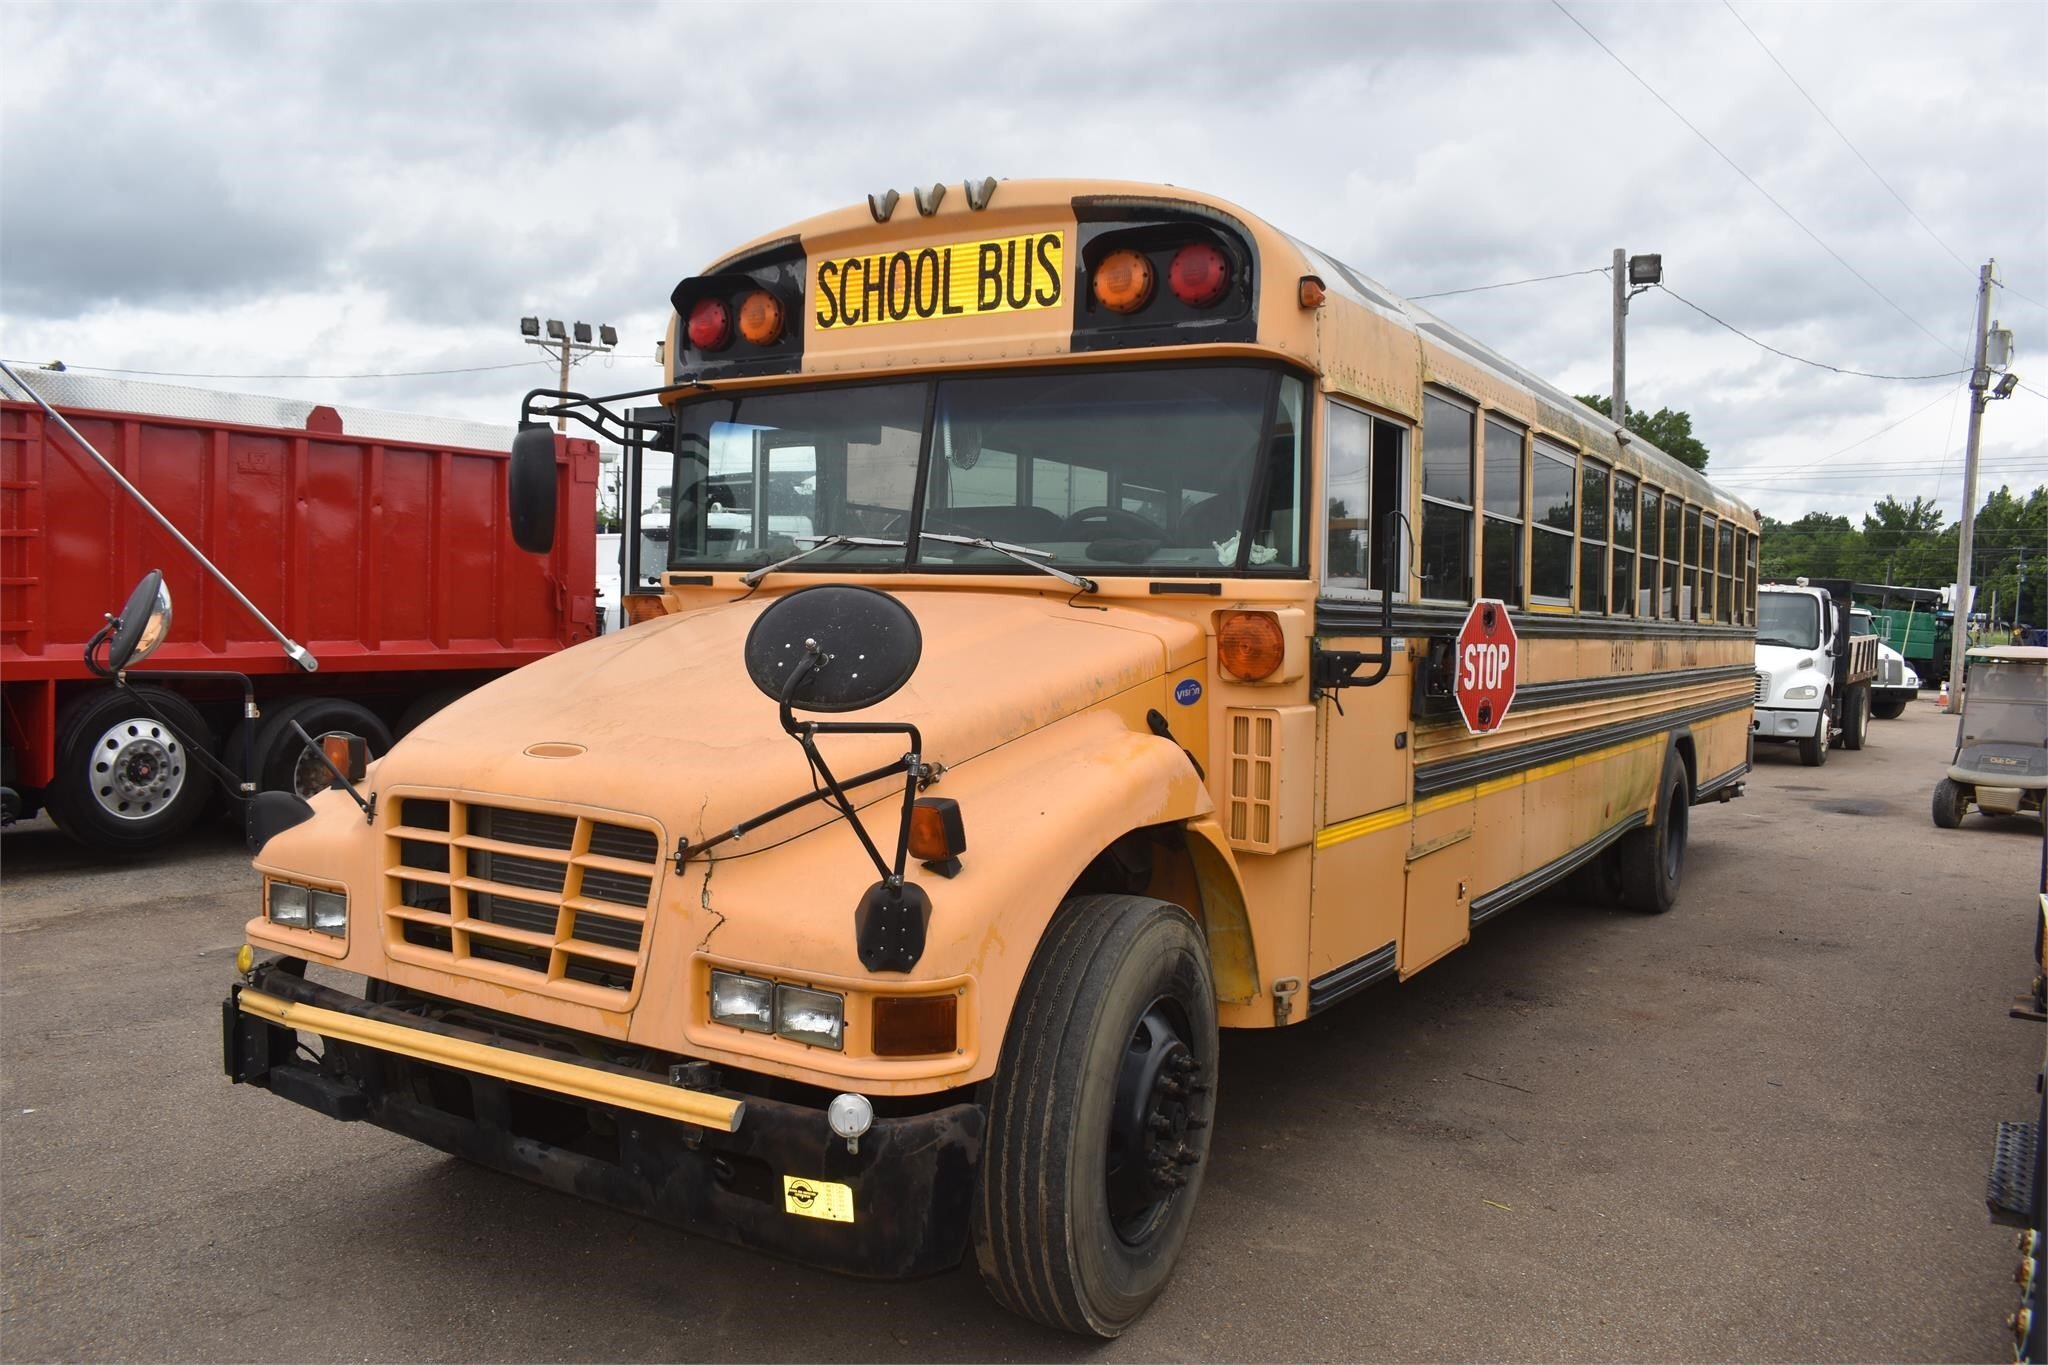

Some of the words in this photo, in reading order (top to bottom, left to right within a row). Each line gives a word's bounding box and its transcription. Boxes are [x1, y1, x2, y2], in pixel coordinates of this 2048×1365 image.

[817, 248, 963, 328] SCHOOL
[978, 234, 1061, 311] BUS
[1464, 644, 1509, 690] STOP
